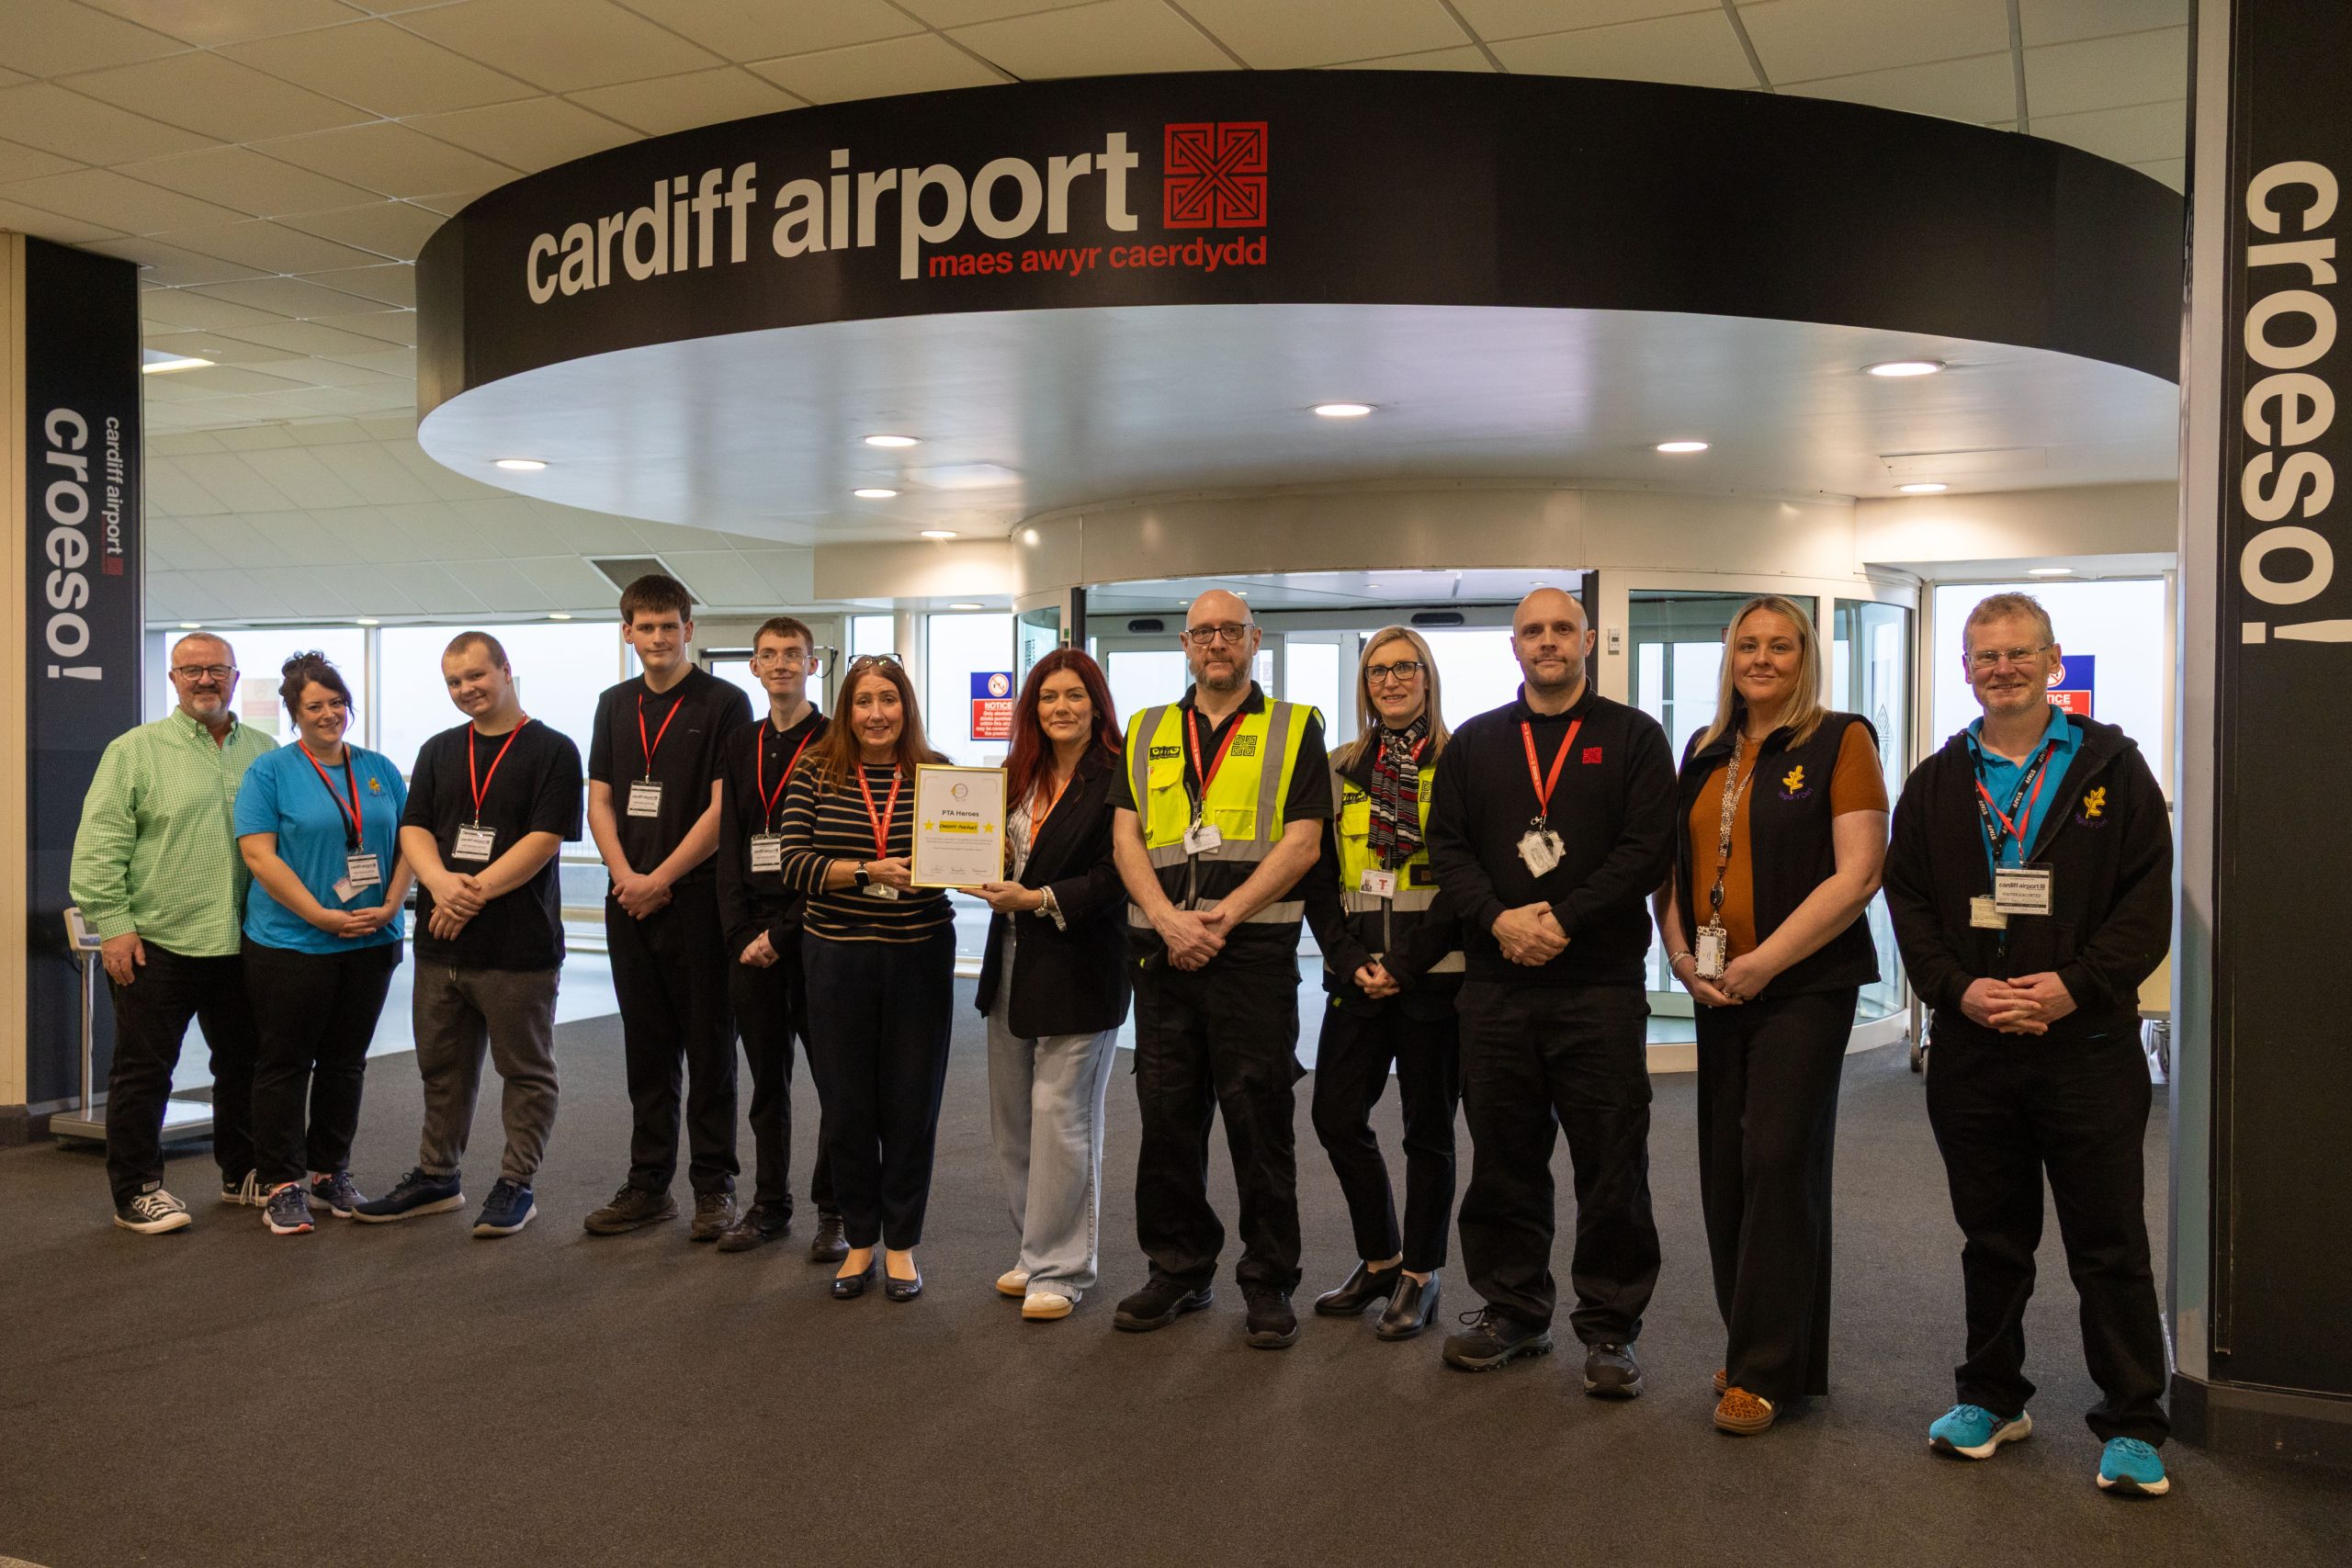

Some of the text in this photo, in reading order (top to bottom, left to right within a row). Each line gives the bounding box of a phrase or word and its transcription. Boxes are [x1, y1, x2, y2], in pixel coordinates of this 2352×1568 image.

[527, 132, 1138, 304] cardiff airport
[929, 236, 1267, 278] maes awyr caerdydd
[2240, 161, 2352, 644] croeso!
[101, 416, 123, 554] cardiff airport
[45, 408, 102, 680] croeso!
[984, 701, 1012, 711] NOTICE
[2025, 769, 2036, 784] STAFF
[1978, 800, 1988, 816] STAFF
[2012, 792, 2023, 808] STAFF
[1986, 824, 1997, 840] STAFF
[1378, 879, 1388, 890] T
